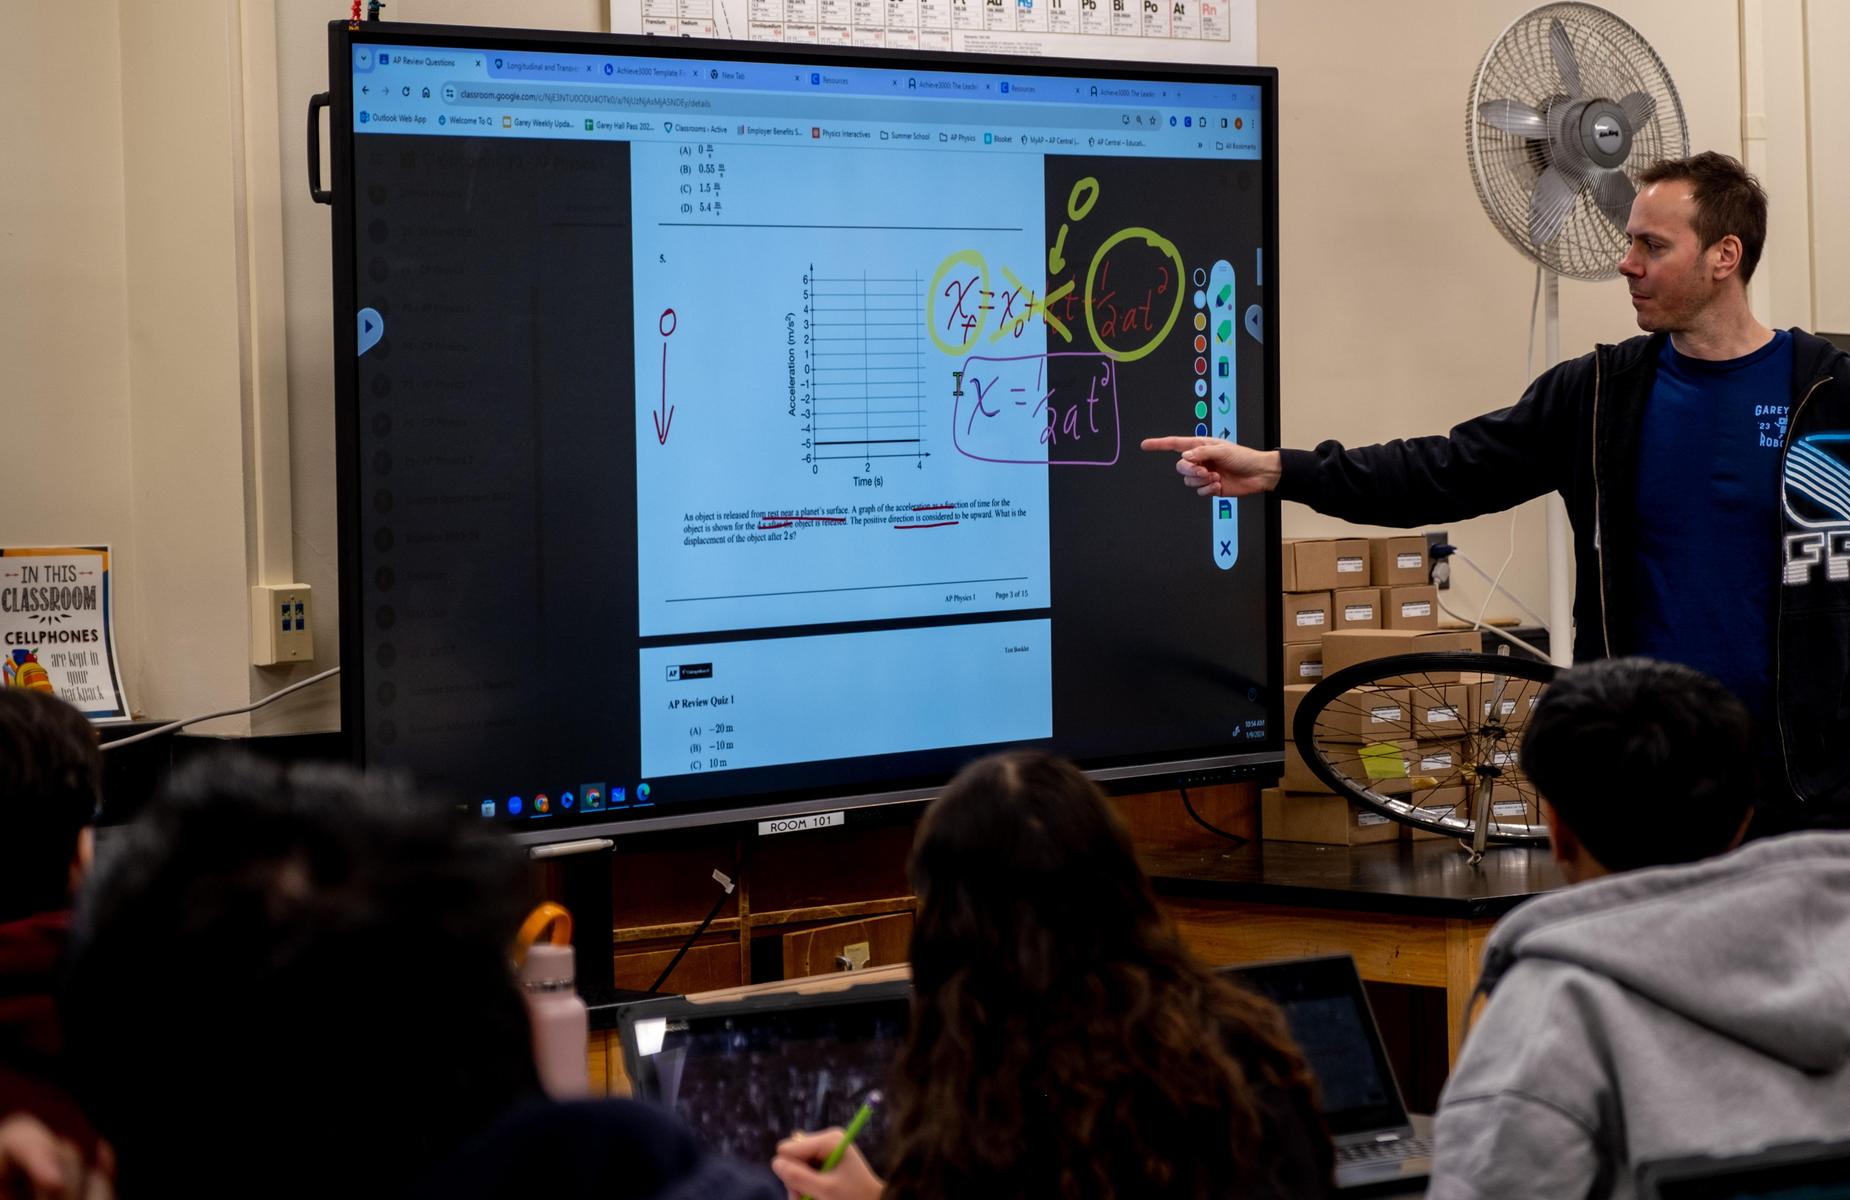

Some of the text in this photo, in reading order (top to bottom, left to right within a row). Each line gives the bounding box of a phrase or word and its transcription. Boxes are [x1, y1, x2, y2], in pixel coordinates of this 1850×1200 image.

[1082, 0, 1096, 10] Pb
[1113, 0, 1124, 11] Bi
[1144, 1, 1158, 13] Po
[1173, 3, 1185, 15] At
[1202, 4, 1217, 15] Rn
[393, 56, 455, 67] AP Review Questions
[507, 62, 554, 72] Longitudinal and
[722, 72, 746, 81] New Tab
[823, 76, 848, 85] Resources
[373, 112, 427, 124] Outlook Web App
[450, 115, 477, 125] Welcome
[478, 116, 486, 125] To
[514, 119, 553, 129] Garey Weekly
[596, 121, 639, 131] Garey Hall Pass
[675, 124, 728, 134] Classrooms Active
[748, 126, 793, 136] Employer Benefits
[822, 129, 871, 139] Physics Interactives
[891, 131, 930, 141] Summer School
[950, 133, 976, 143] AP Physics
[679, 144, 704, 157] (A) 0
[680, 163, 715, 175] (B) 0.55
[680, 182, 711, 195] (C) 1.5
[680, 202, 712, 214] (D) 5.4
[802, 275, 809, 284] 6
[803, 290, 809, 299] 5
[803, 305, 809, 314] 4
[803, 320, 810, 329] 3
[803, 334, 810, 344] 2
[804, 365, 810, 374] 0
[788, 348, 796, 417] Acceleration
[1755, 404, 1790, 417] GAREY
[812, 461, 923, 475] 0 2 4
[853, 476, 884, 488] Time (s)
[684, 513, 694, 521] An
[695, 512, 715, 523] object
[716, 512, 722, 520] is
[723, 510, 749, 520] released
[751, 509, 766, 519] from
[768, 510, 779, 518] rest
[801, 506, 825, 518] planet's
[859, 504, 876, 516] graph
[877, 503, 885, 512] of
[885, 503, 895, 512] the
[896, 502, 931, 512] acceleration
[945, 500, 969, 509] function
[970, 499, 977, 508] of
[977, 499, 991, 508] time
[992, 498, 1000, 507] for
[1001, 498, 1010, 507] the
[683, 524, 704, 535] object
[705, 523, 711, 532] is
[712, 522, 733, 532] shown
[734, 521, 744, 531] for
[745, 521, 756, 530] the
[794, 519, 814, 529] object
[815, 519, 821, 527] is
[850, 516, 862, 525] The
[863, 515, 887, 526] positive
[888, 514, 914, 524] direction
[915, 513, 921, 522] is
[922, 512, 954, 522] considered
[955, 512, 961, 520] to
[962, 511, 969, 519] be
[970, 509, 993, 521] upward.
[995, 509, 1011, 518] What
[1011, 508, 1017, 517] is
[1017, 507, 1026, 517] the
[683, 535, 726, 548] displacement
[727, 534, 736, 544] of
[735, 534, 746, 543] the
[747, 533, 767, 544] object
[768, 532, 782, 542] after
[21, 564, 77, 584] IN THIS
[1, 585, 97, 613] CLASSROOM
[945, 593, 972, 604] AP Physics
[995, 591, 1008, 601] Page
[1014, 590, 1021, 598] of
[1021, 589, 1029, 598] 15
[5, 629, 99, 645] CELLPHONES
[51, 651, 99, 669] are kept in
[66, 669, 89, 687] your
[669, 670, 677, 678] AP
[60, 686, 105, 703] backpack
[668, 695, 729, 710] AP Review Quiz
[690, 727, 702, 737] (A)
[690, 743, 702, 754] (B)
[690, 761, 702, 772] (C)
[770, 816, 832, 833] ROOM 101
